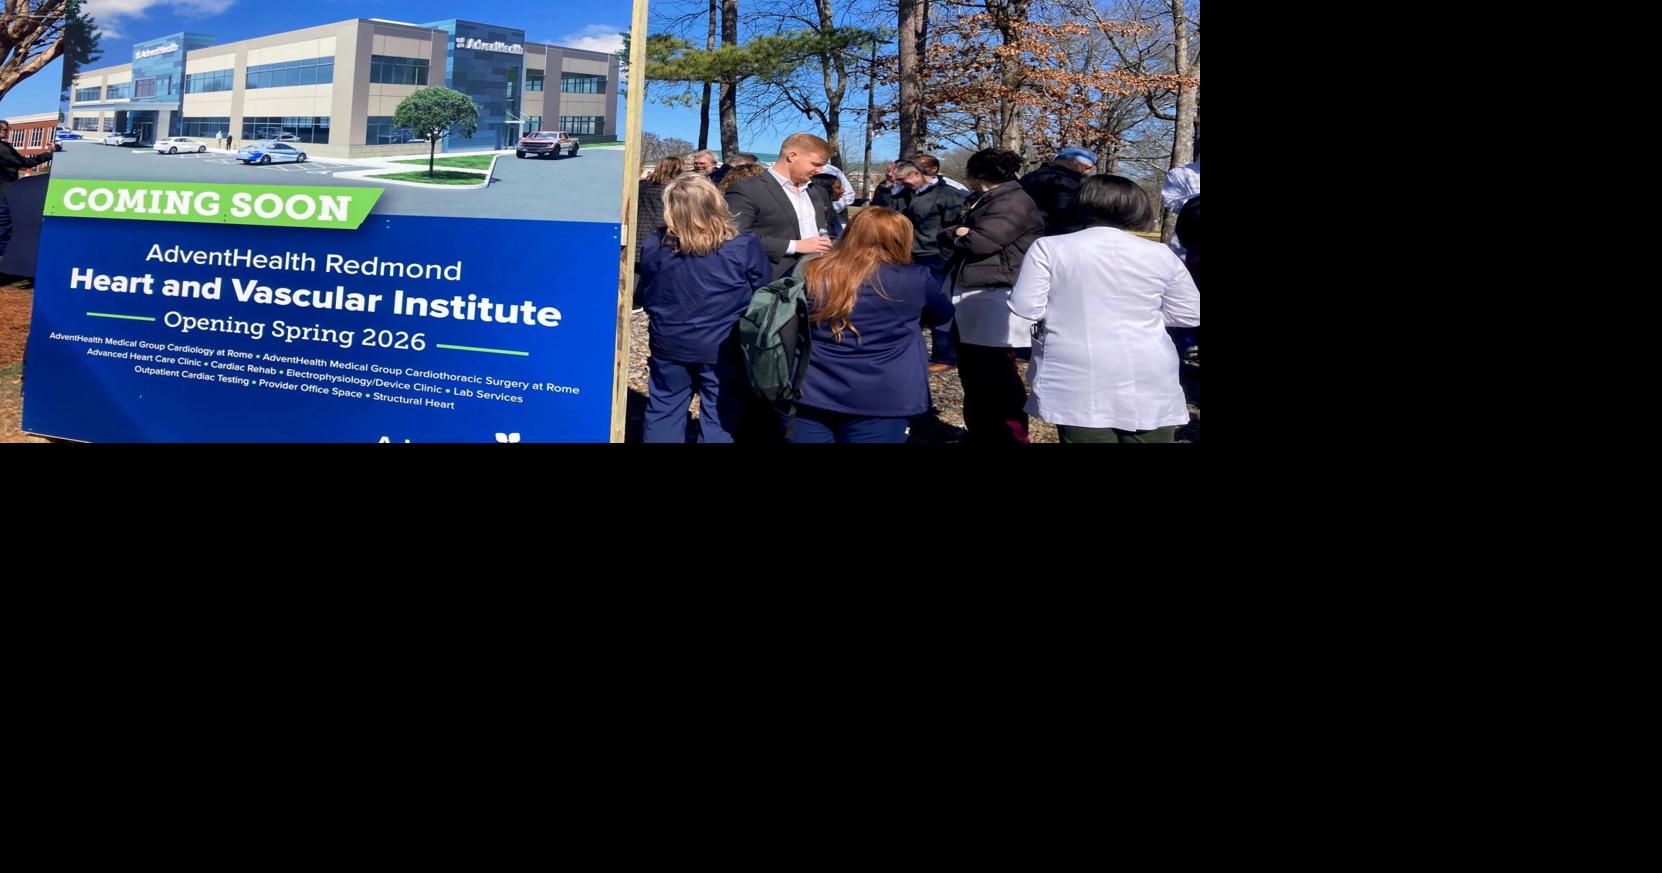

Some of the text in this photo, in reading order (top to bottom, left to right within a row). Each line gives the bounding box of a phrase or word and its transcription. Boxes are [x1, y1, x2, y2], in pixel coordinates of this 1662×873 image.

[63, 187, 352, 222] COMING SOON
[146, 243, 462, 281] AdventHealth Redmond
[70, 267, 562, 328] Heart and Vascular Institute
[164, 311, 426, 351] Opening Spring 2026
[49, 332, 580, 395] AdventHealth Medical Group Cardiology at Rome AdventHealth Medical Group Cardiothoracic Surgery at Rome
[87, 347, 524, 404] Advanced Heart Care Clinic Cardiac Rehab Electrophysiology/Device Clinic Lab Services
[134, 365, 455, 410] Outpatient Cardiac Testing Provider Office Space Structural Heart
